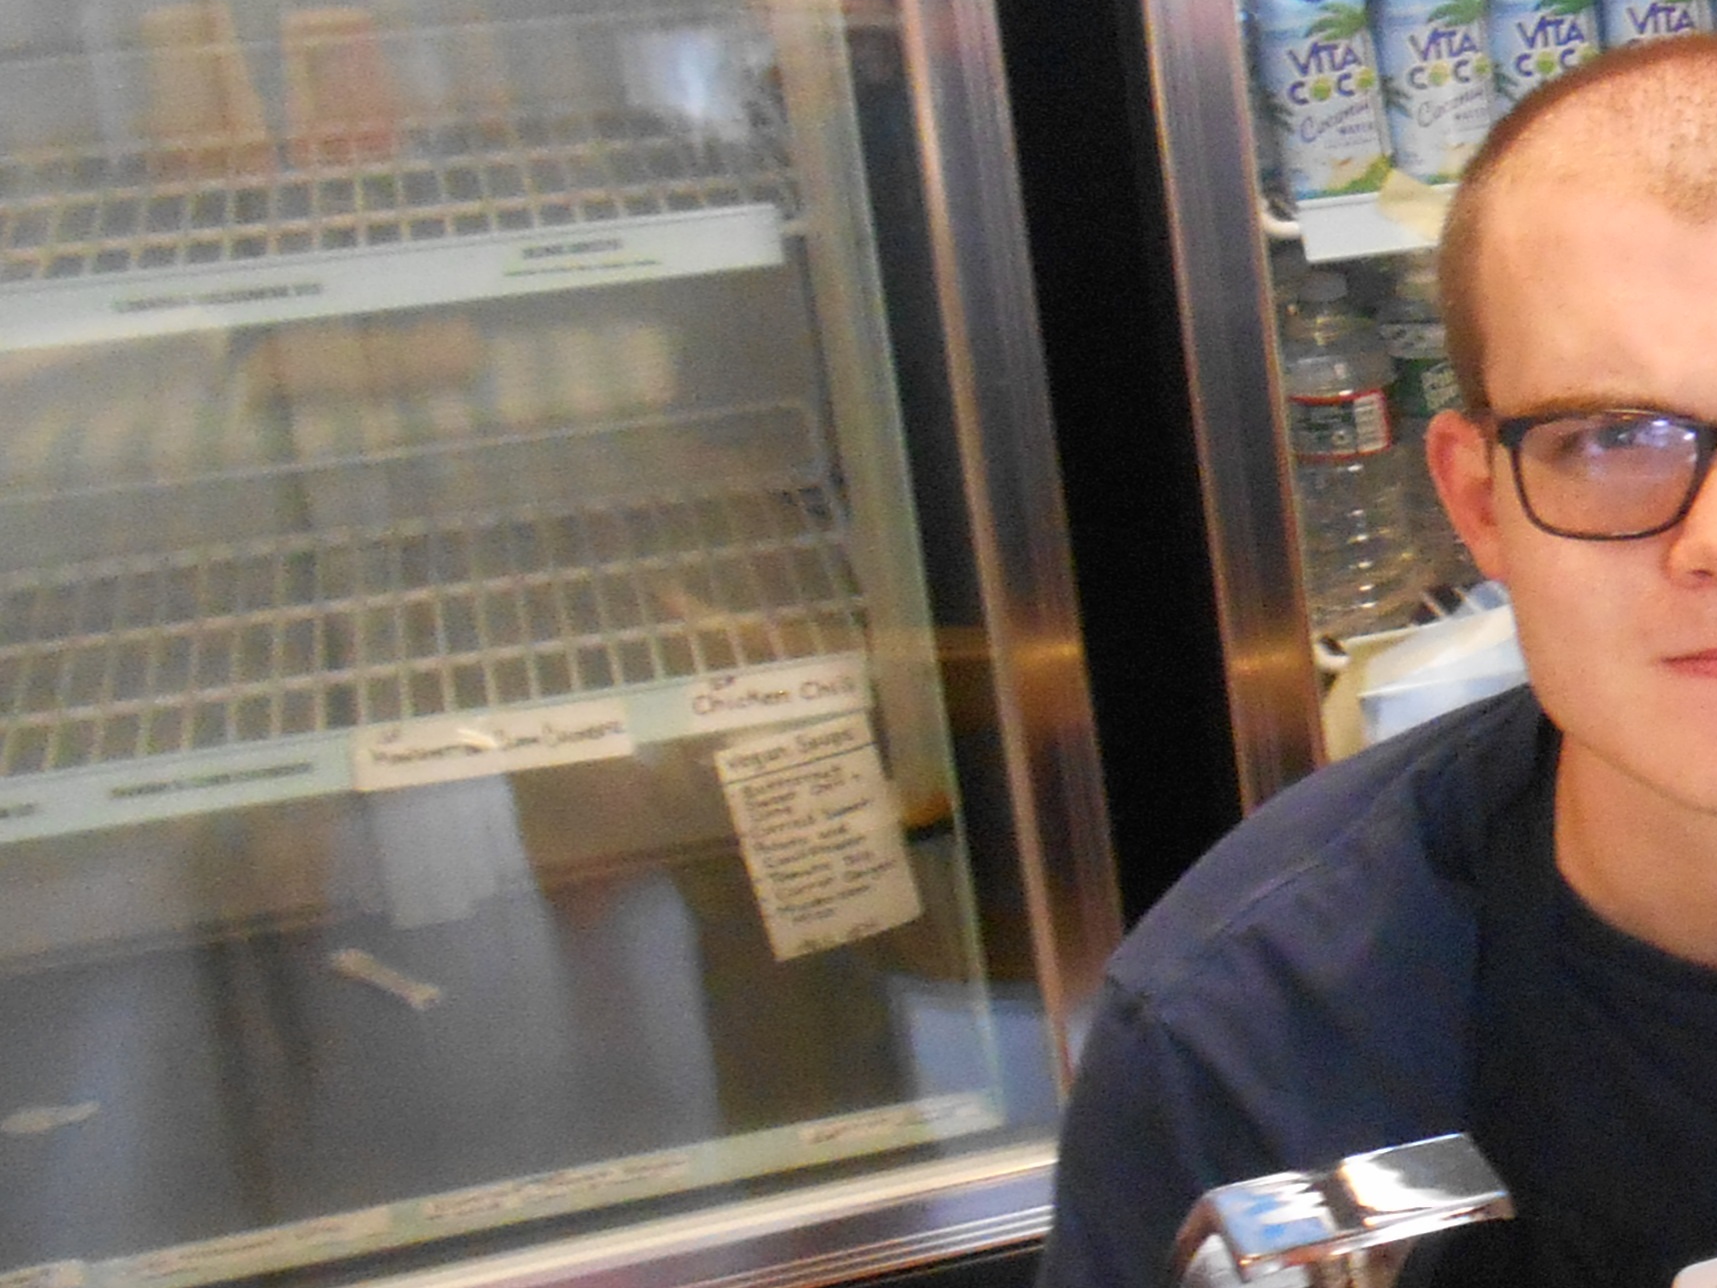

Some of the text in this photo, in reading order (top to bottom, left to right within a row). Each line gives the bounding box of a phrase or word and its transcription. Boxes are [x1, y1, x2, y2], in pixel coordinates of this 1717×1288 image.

[1515, 14, 1586, 49] VITA
[1627, 1, 1696, 35] VITA
[1287, 41, 1362, 77] VITA
[1407, 26, 1480, 61] VITA
[1287, 65, 1376, 106] COCO
[1407, 53, 1491, 90] COCO
